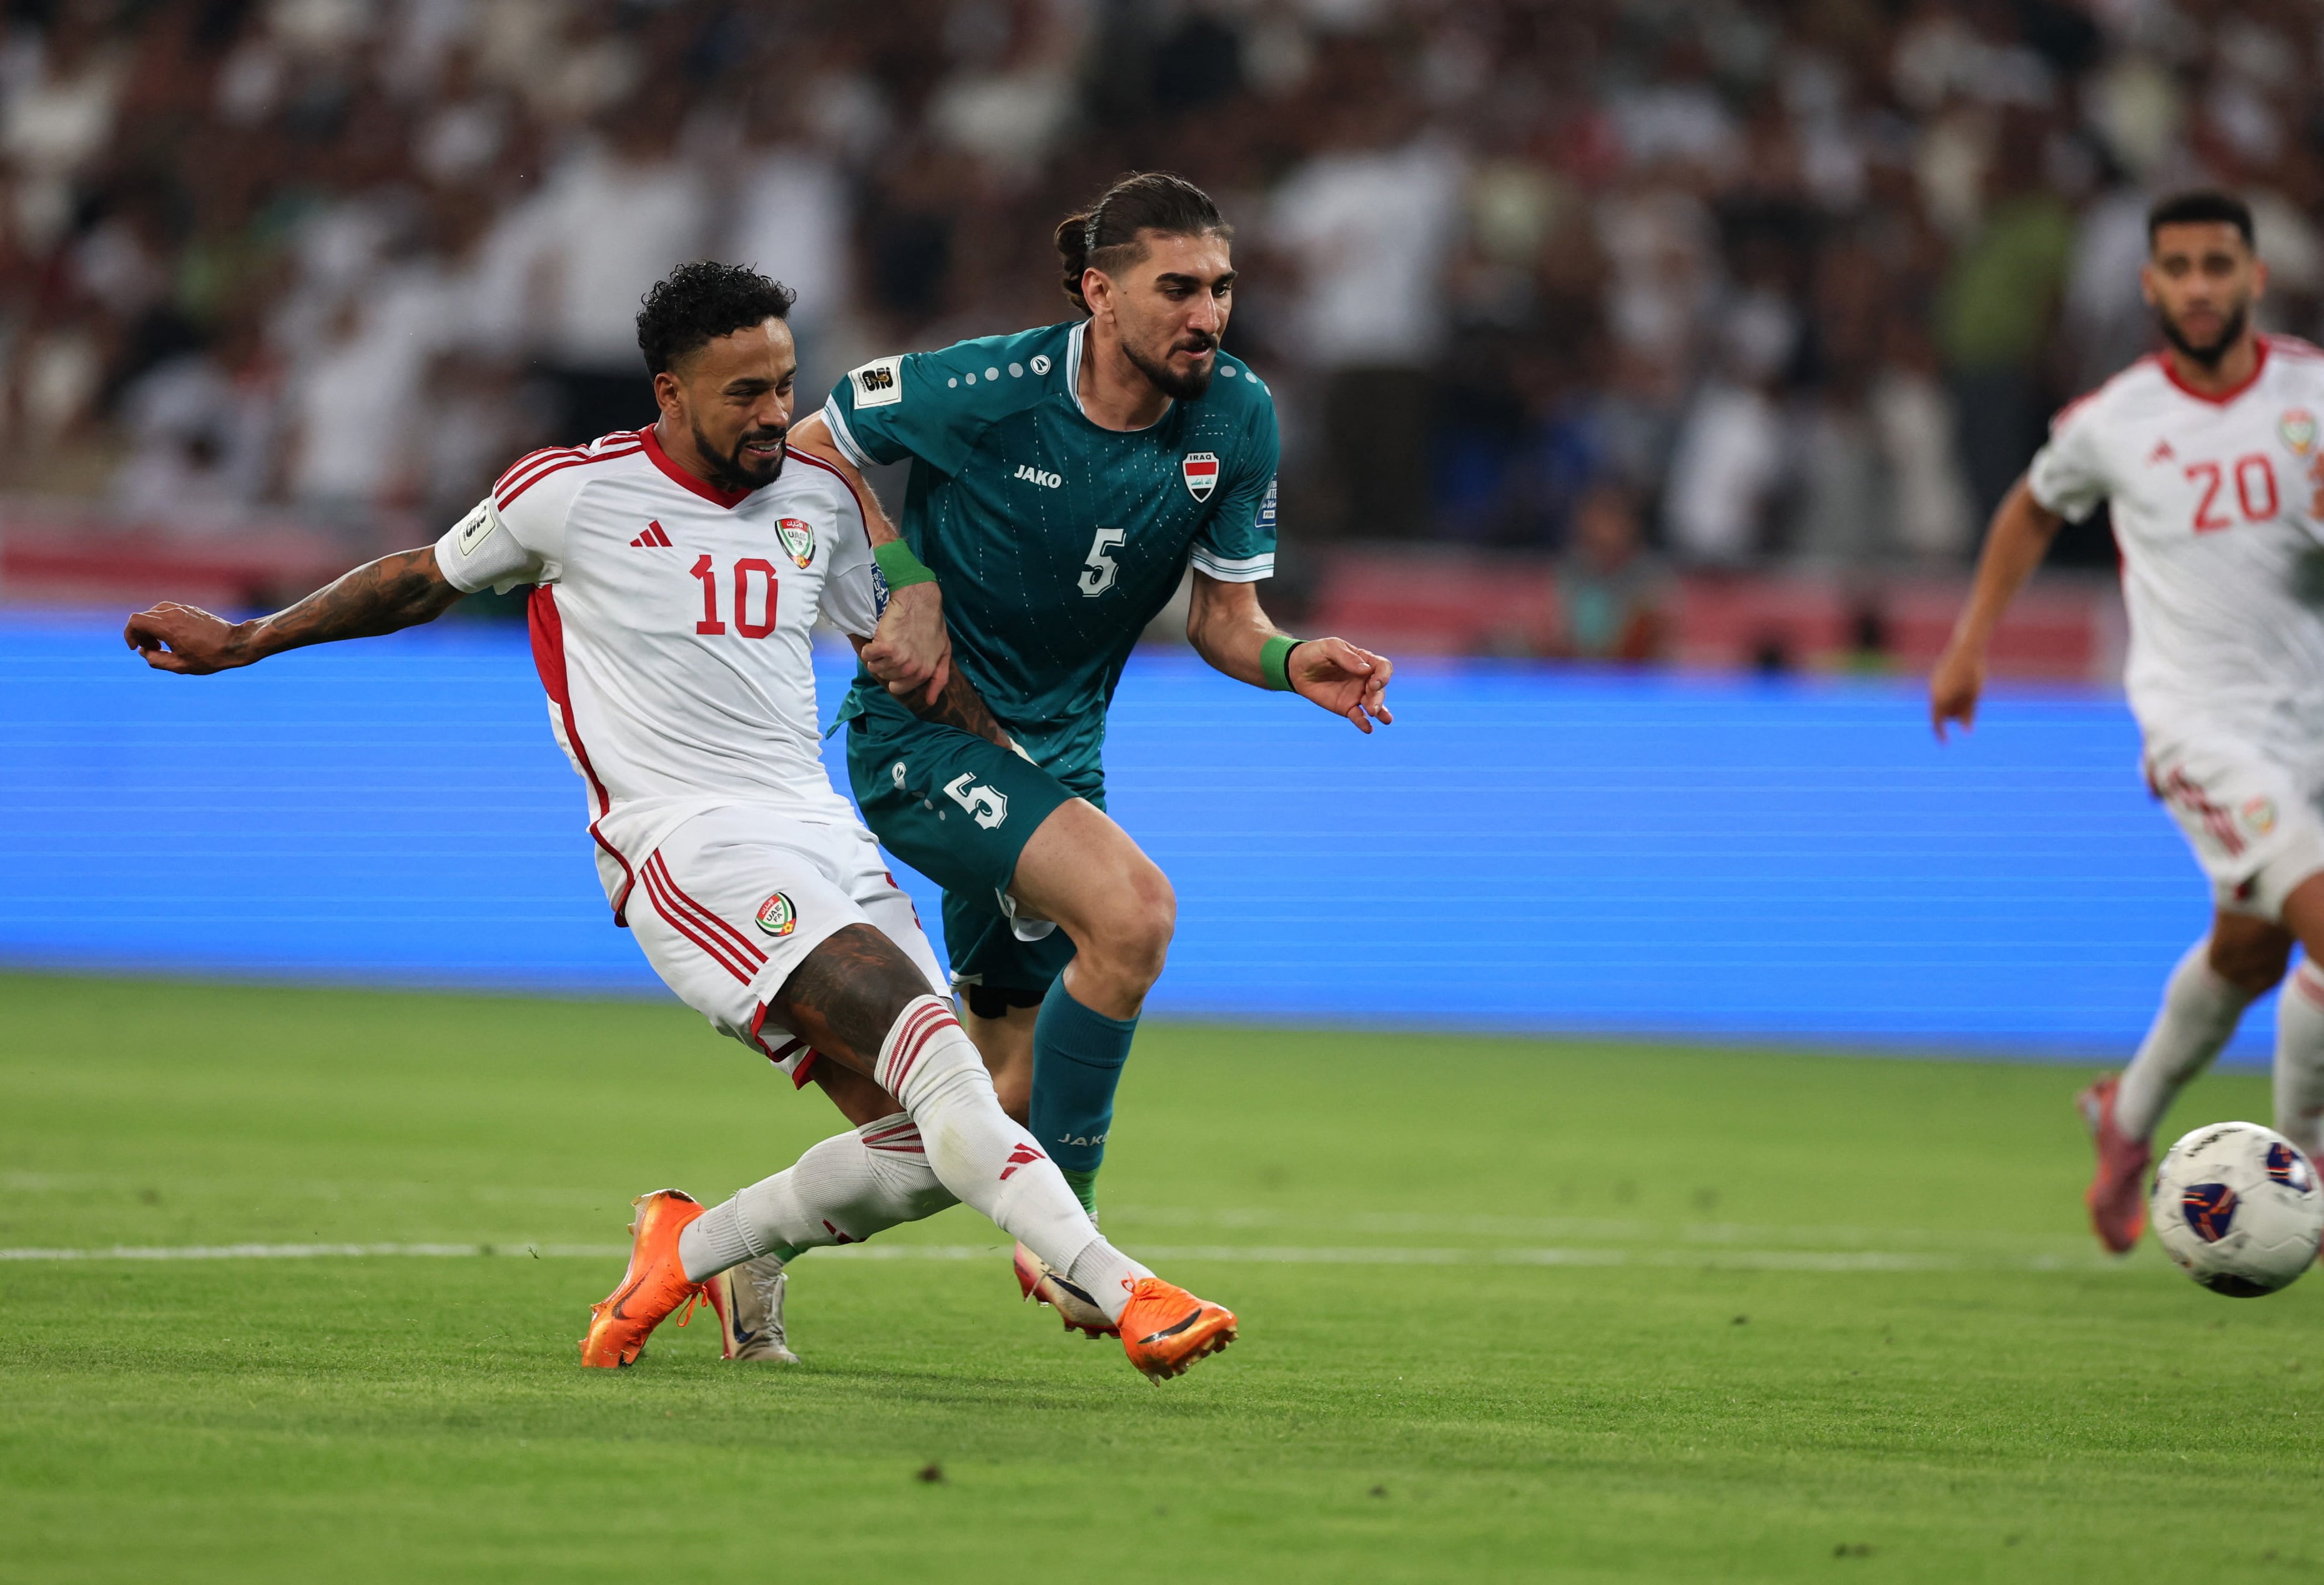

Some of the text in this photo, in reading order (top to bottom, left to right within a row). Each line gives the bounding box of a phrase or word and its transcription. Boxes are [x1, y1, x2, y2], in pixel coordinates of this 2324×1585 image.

[1013, 464, 1061, 488] JAKO
[2183, 455, 2280, 535] 20
[1077, 528, 1127, 598] 5
[689, 554, 779, 639] 10
[942, 771, 1008, 830] 5
[766, 904, 782, 922] UAE
[773, 912, 783, 922] FA
